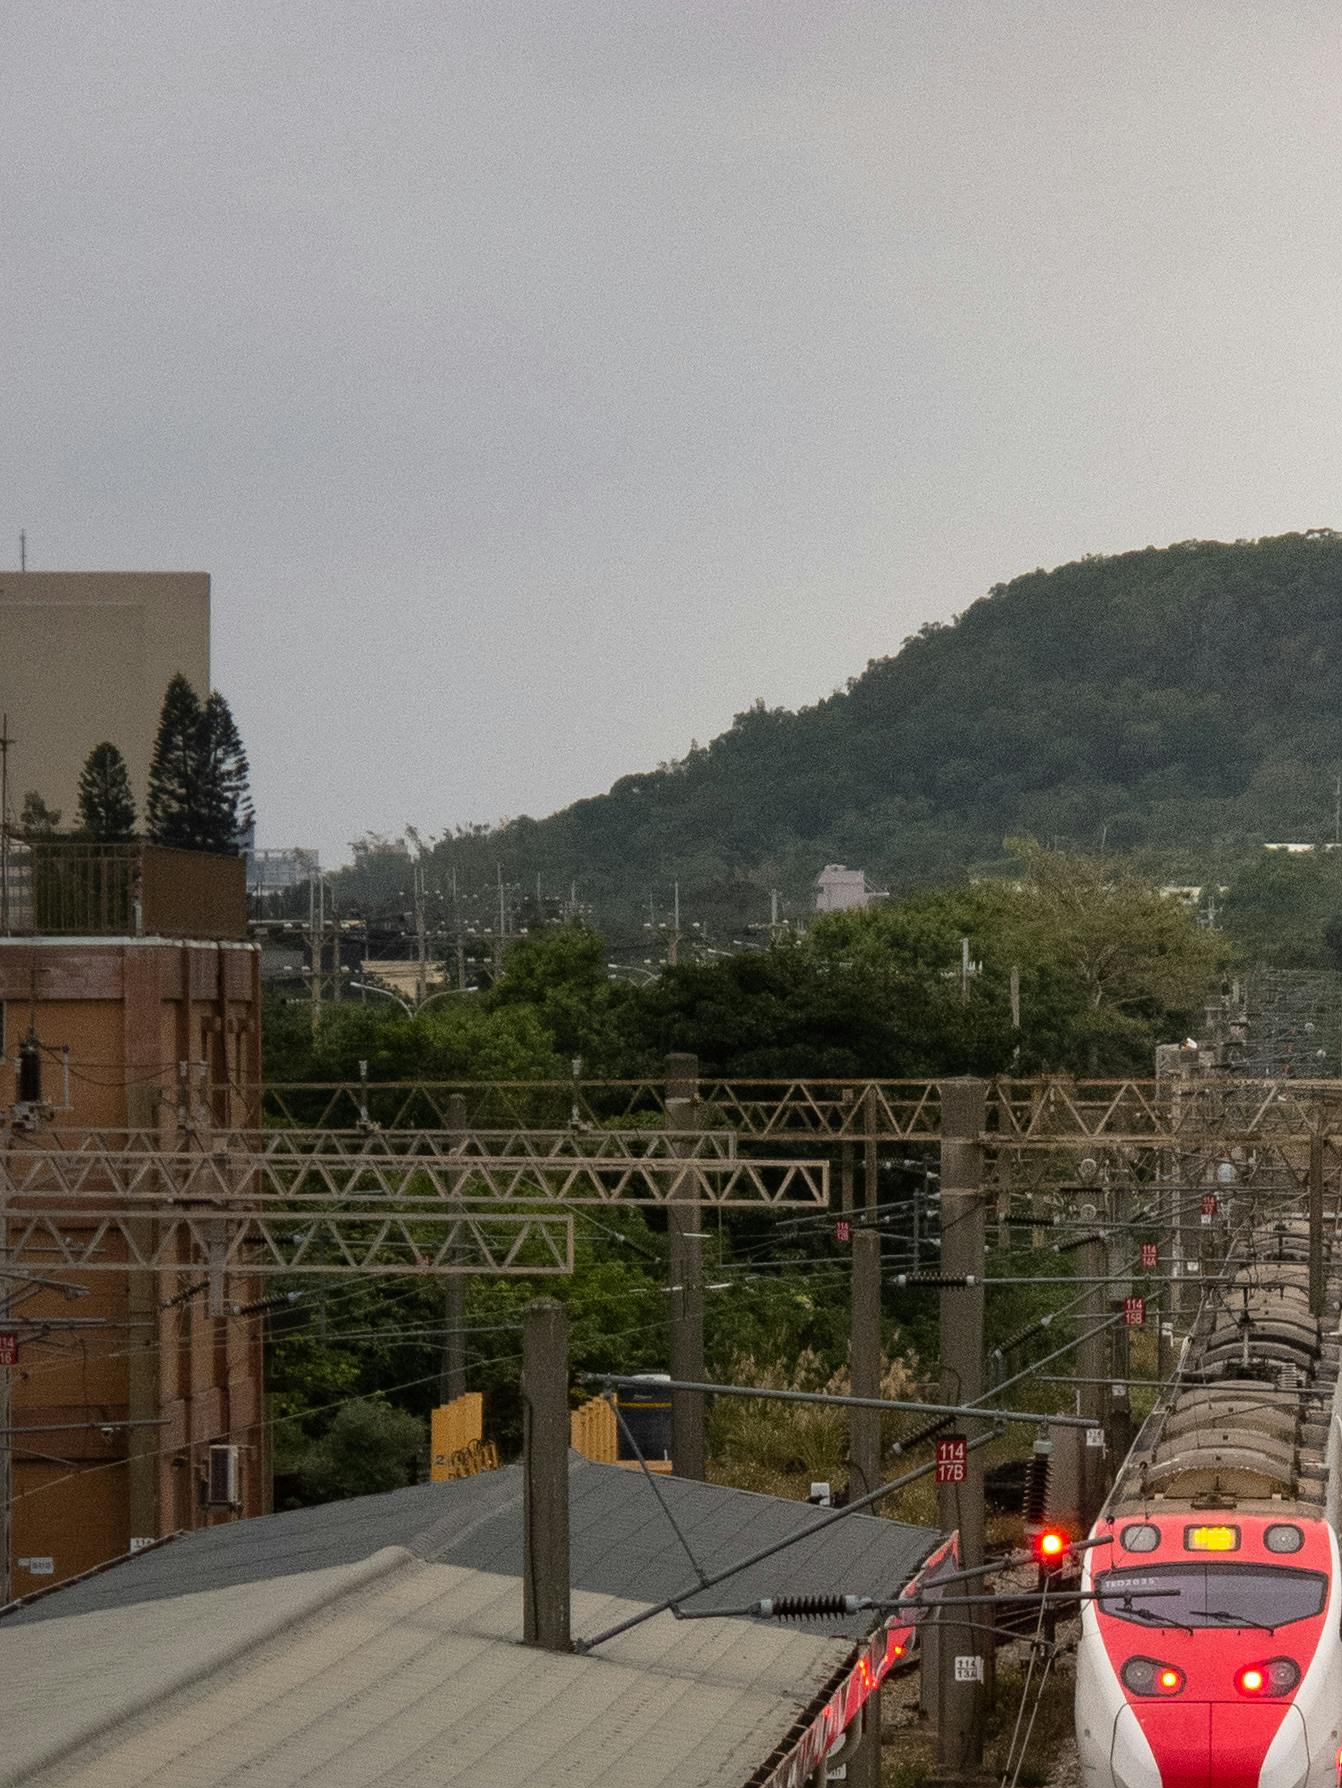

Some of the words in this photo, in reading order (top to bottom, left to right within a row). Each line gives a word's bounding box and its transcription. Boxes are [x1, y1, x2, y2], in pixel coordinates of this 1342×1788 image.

[1142, 1245, 1156, 1254] 114
[1126, 1299, 1143, 1309] 114
[1125, 1313, 1143, 1324] 15B
[940, 1443, 964, 1460] 114
[938, 1464, 964, 1481] 17B
